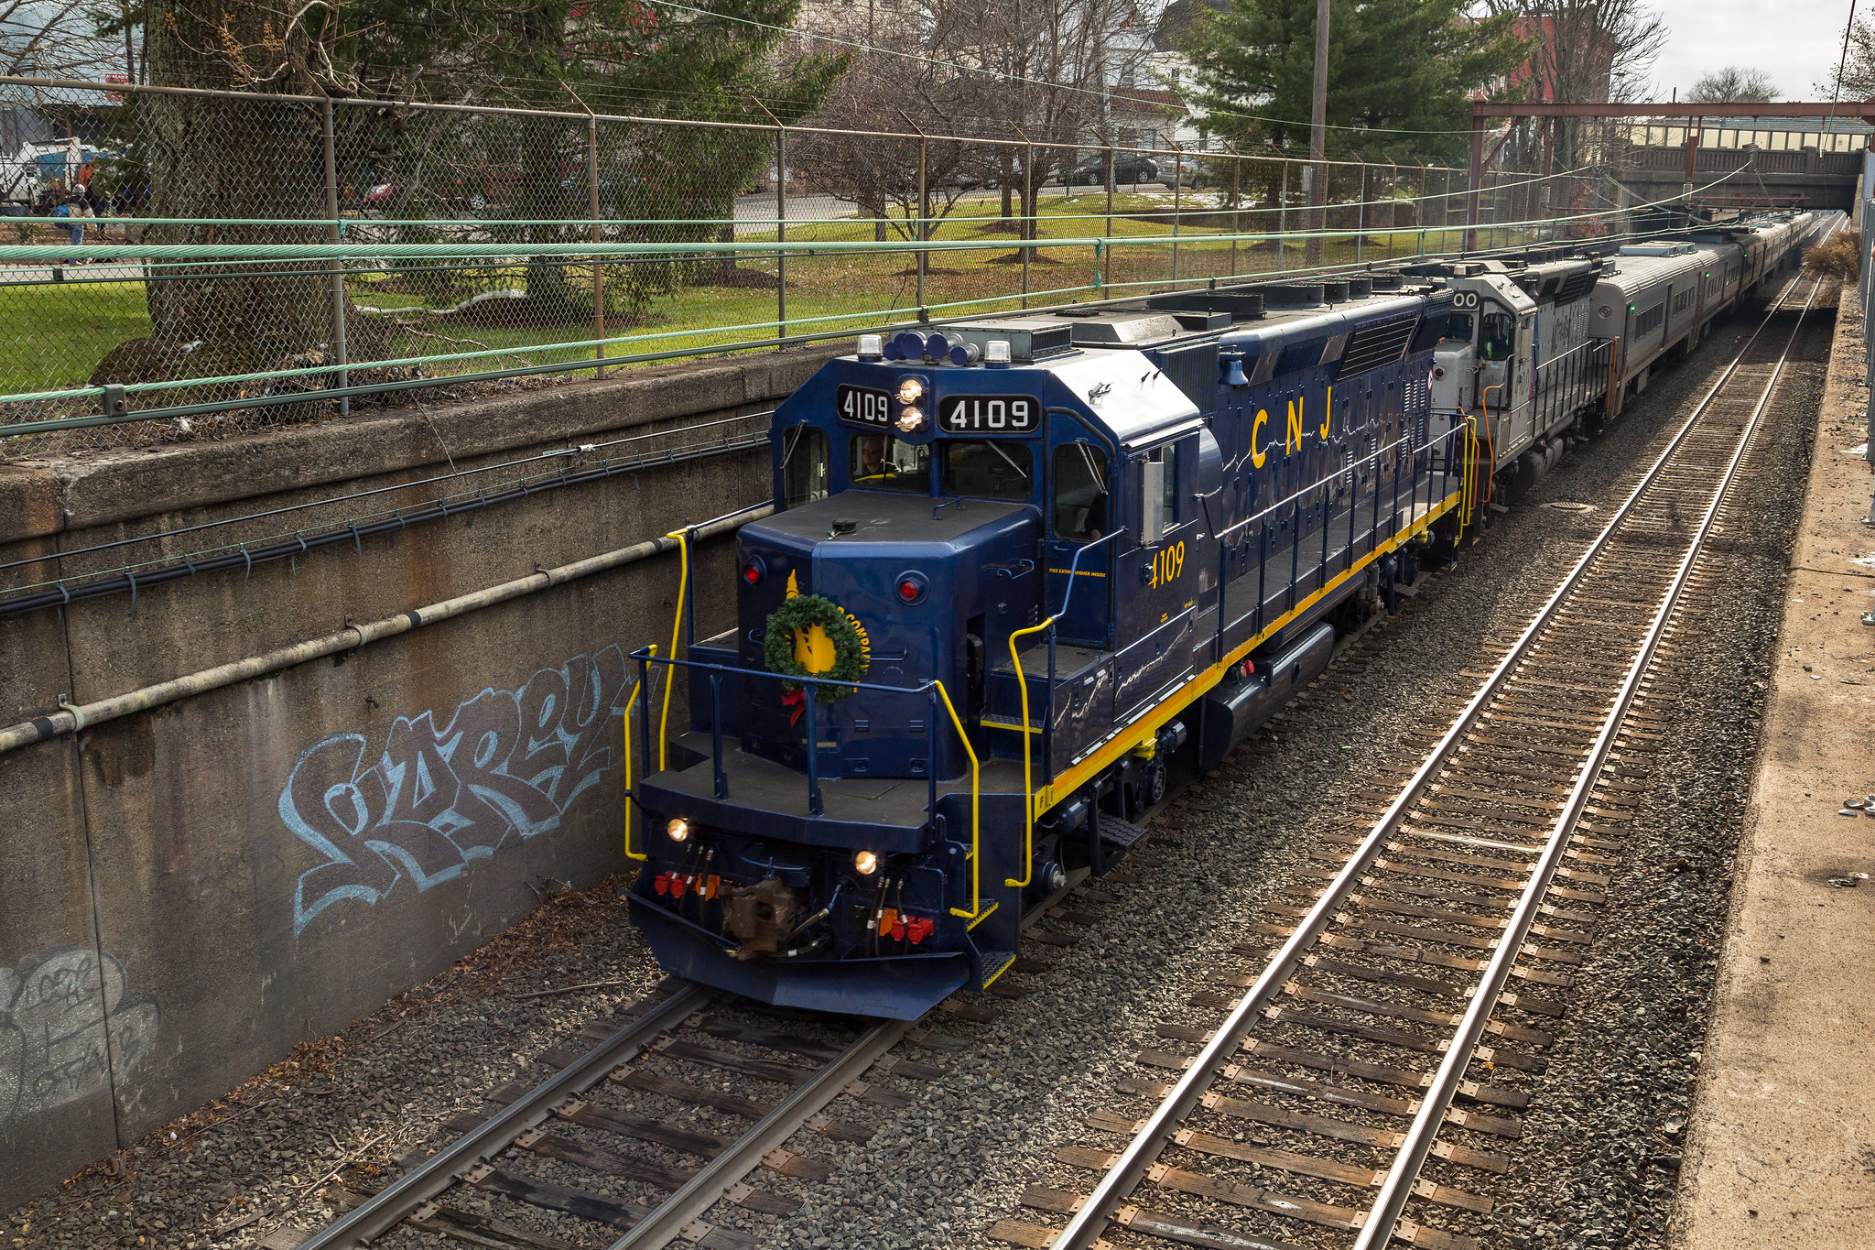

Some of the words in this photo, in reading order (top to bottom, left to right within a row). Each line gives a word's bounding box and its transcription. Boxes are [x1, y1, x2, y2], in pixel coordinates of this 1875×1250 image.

[843, 390, 888, 422] 4109
[950, 400, 1029, 428] 4109
[1148, 540, 1185, 590] 4109
